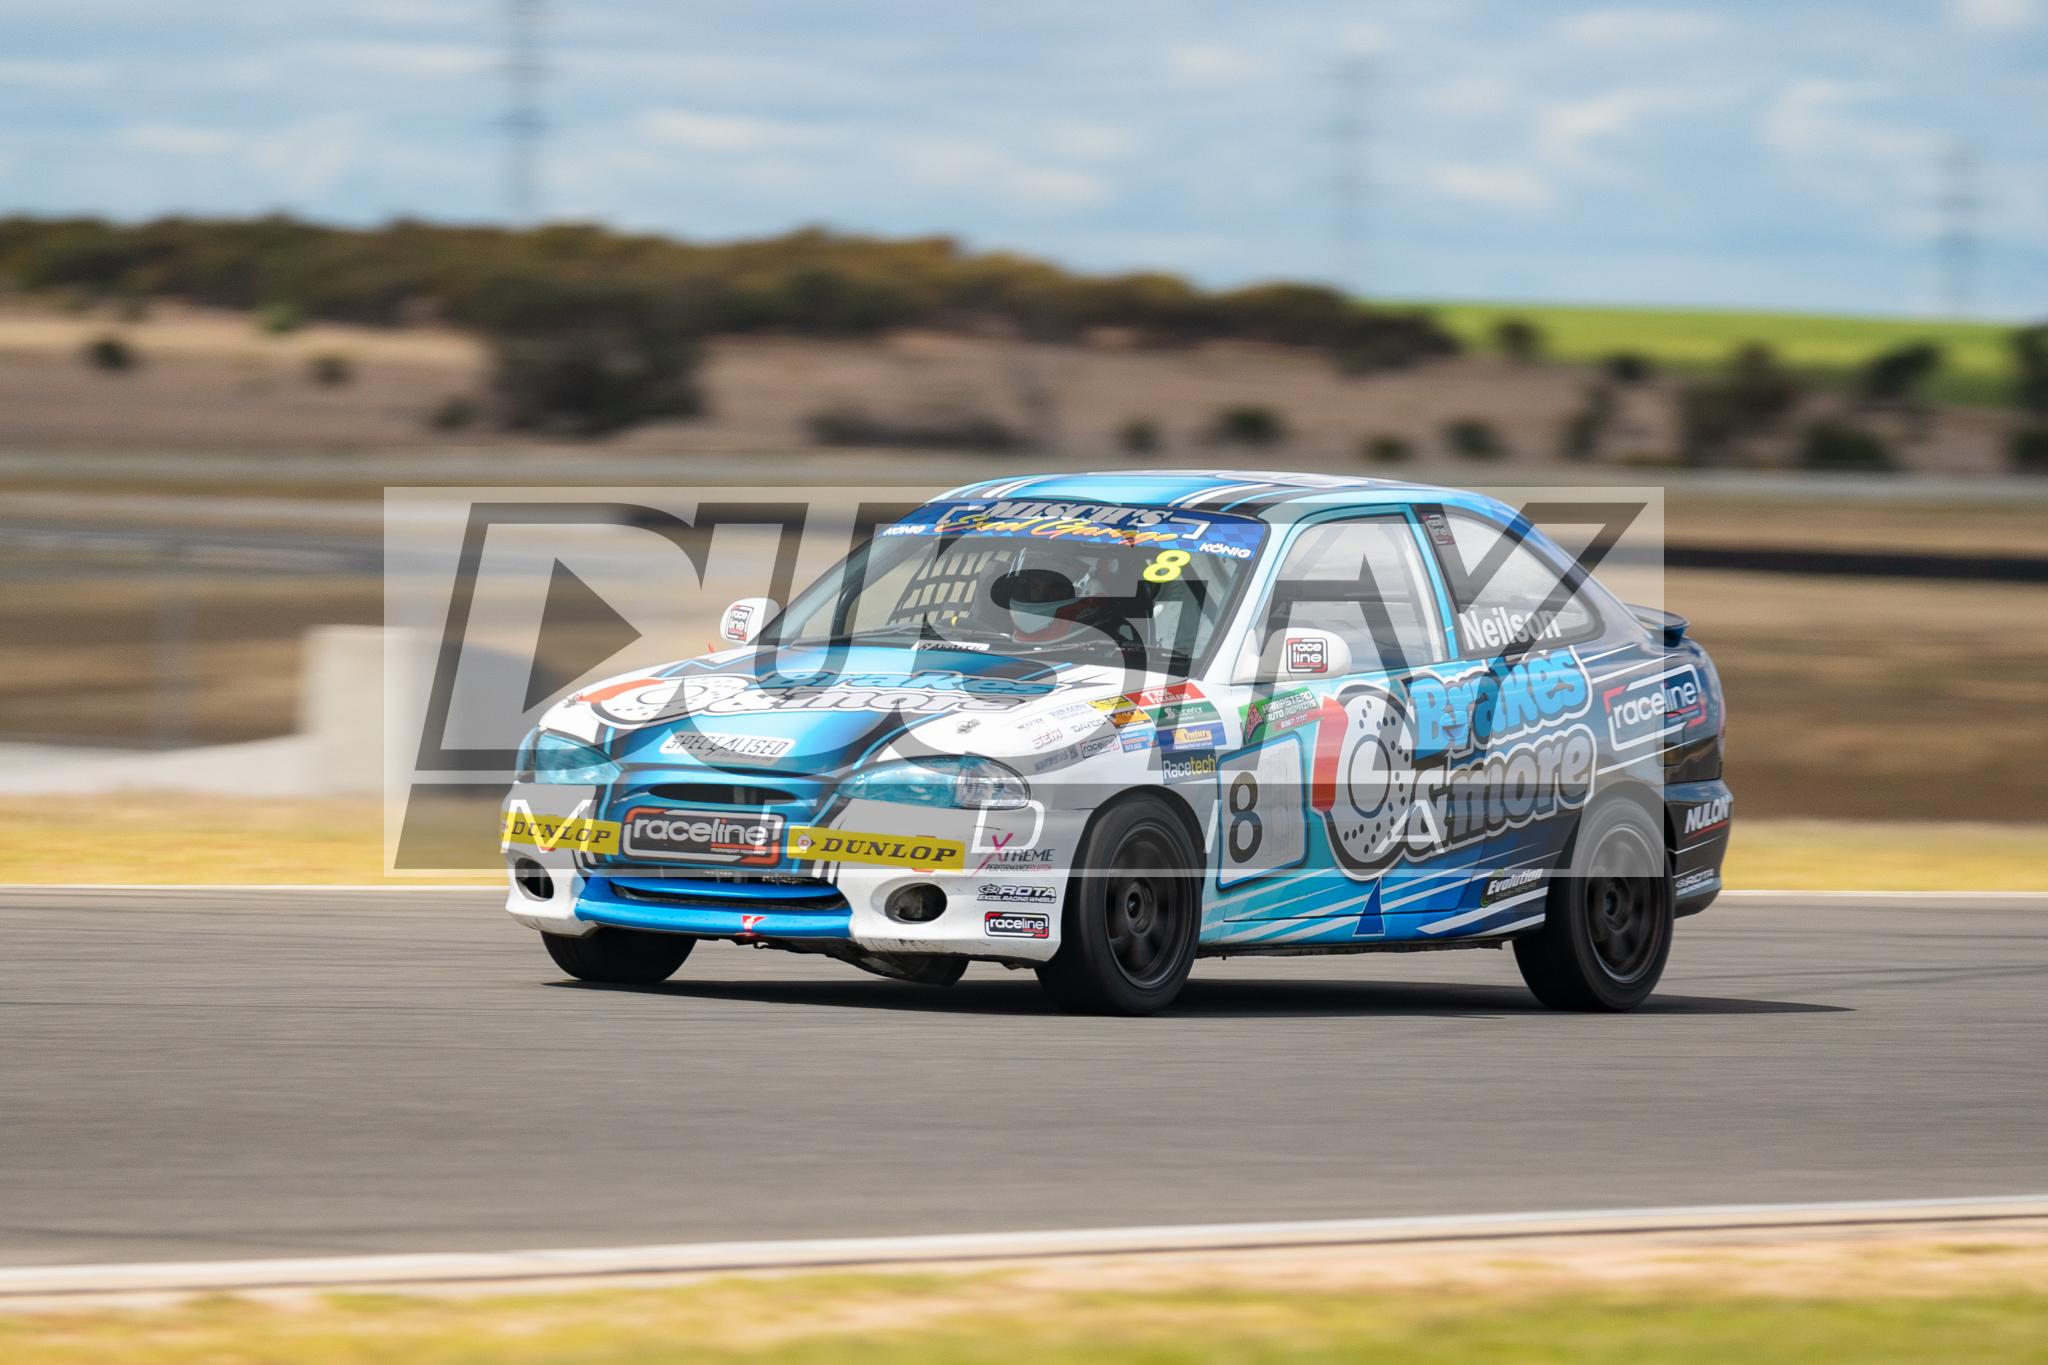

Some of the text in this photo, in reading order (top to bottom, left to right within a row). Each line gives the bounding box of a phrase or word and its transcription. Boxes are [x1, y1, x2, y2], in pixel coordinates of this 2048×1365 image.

[982, 502, 1173, 527] MISCH'S
[1031, 517, 1179, 545] Garage
[1143, 549, 1191, 583] 8
[1459, 607, 1561, 652] Neilson
[1293, 643, 1322, 652] race
[1293, 652, 1322, 663] line
[764, 671, 1057, 693] Brakes
[1411, 649, 1586, 760] Brakes
[1613, 681, 1697, 728] raceline
[1163, 756, 1216, 779] Racetech
[1229, 771, 1262, 863] 8
[1684, 795, 1731, 834] NULON
[511, 820, 612, 844] DUNLOP
[632, 817, 770, 846] raceline
[820, 836, 958, 863] DUNLOP
[973, 832, 1056, 874] XTREME
[999, 884, 1056, 898] ROTA
[1486, 869, 1543, 896] Evolution
[989, 917, 1044, 930] raceline
